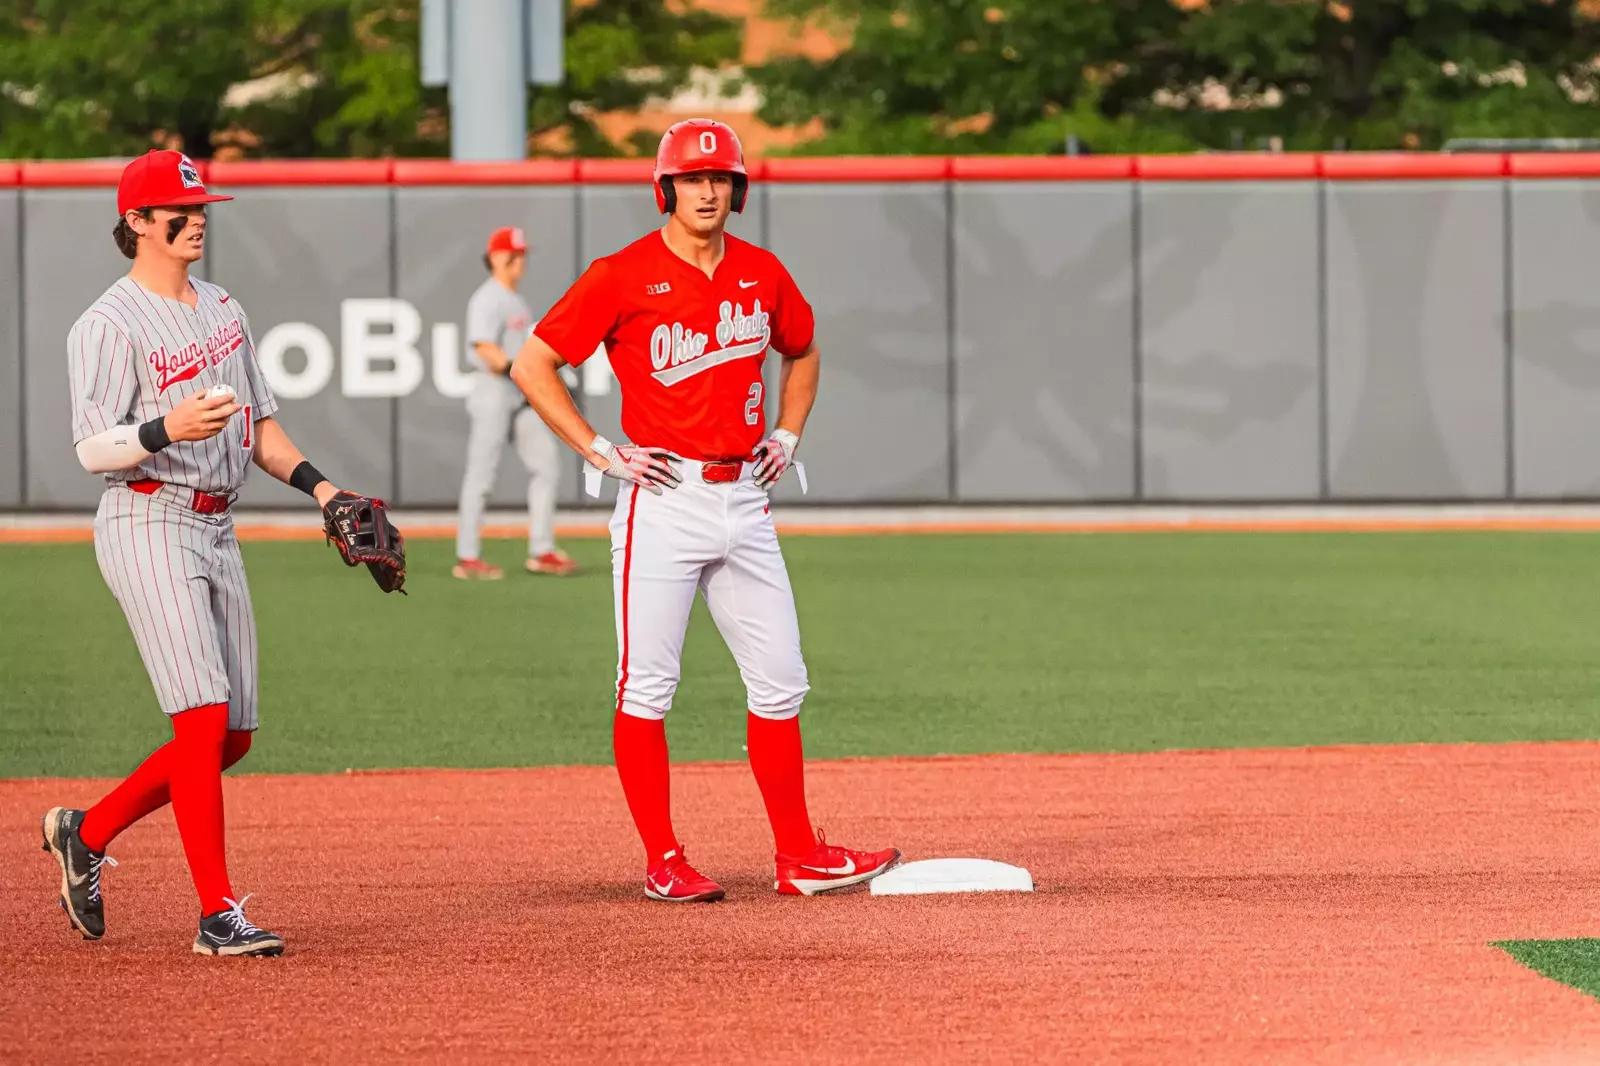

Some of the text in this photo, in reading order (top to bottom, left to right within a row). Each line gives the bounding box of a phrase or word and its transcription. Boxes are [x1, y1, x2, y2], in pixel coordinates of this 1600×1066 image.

[699, 131, 717, 154] O
[650, 298, 769, 371] Ohio State
[744, 382, 762, 425] 2
[241, 403, 253, 449] 1
